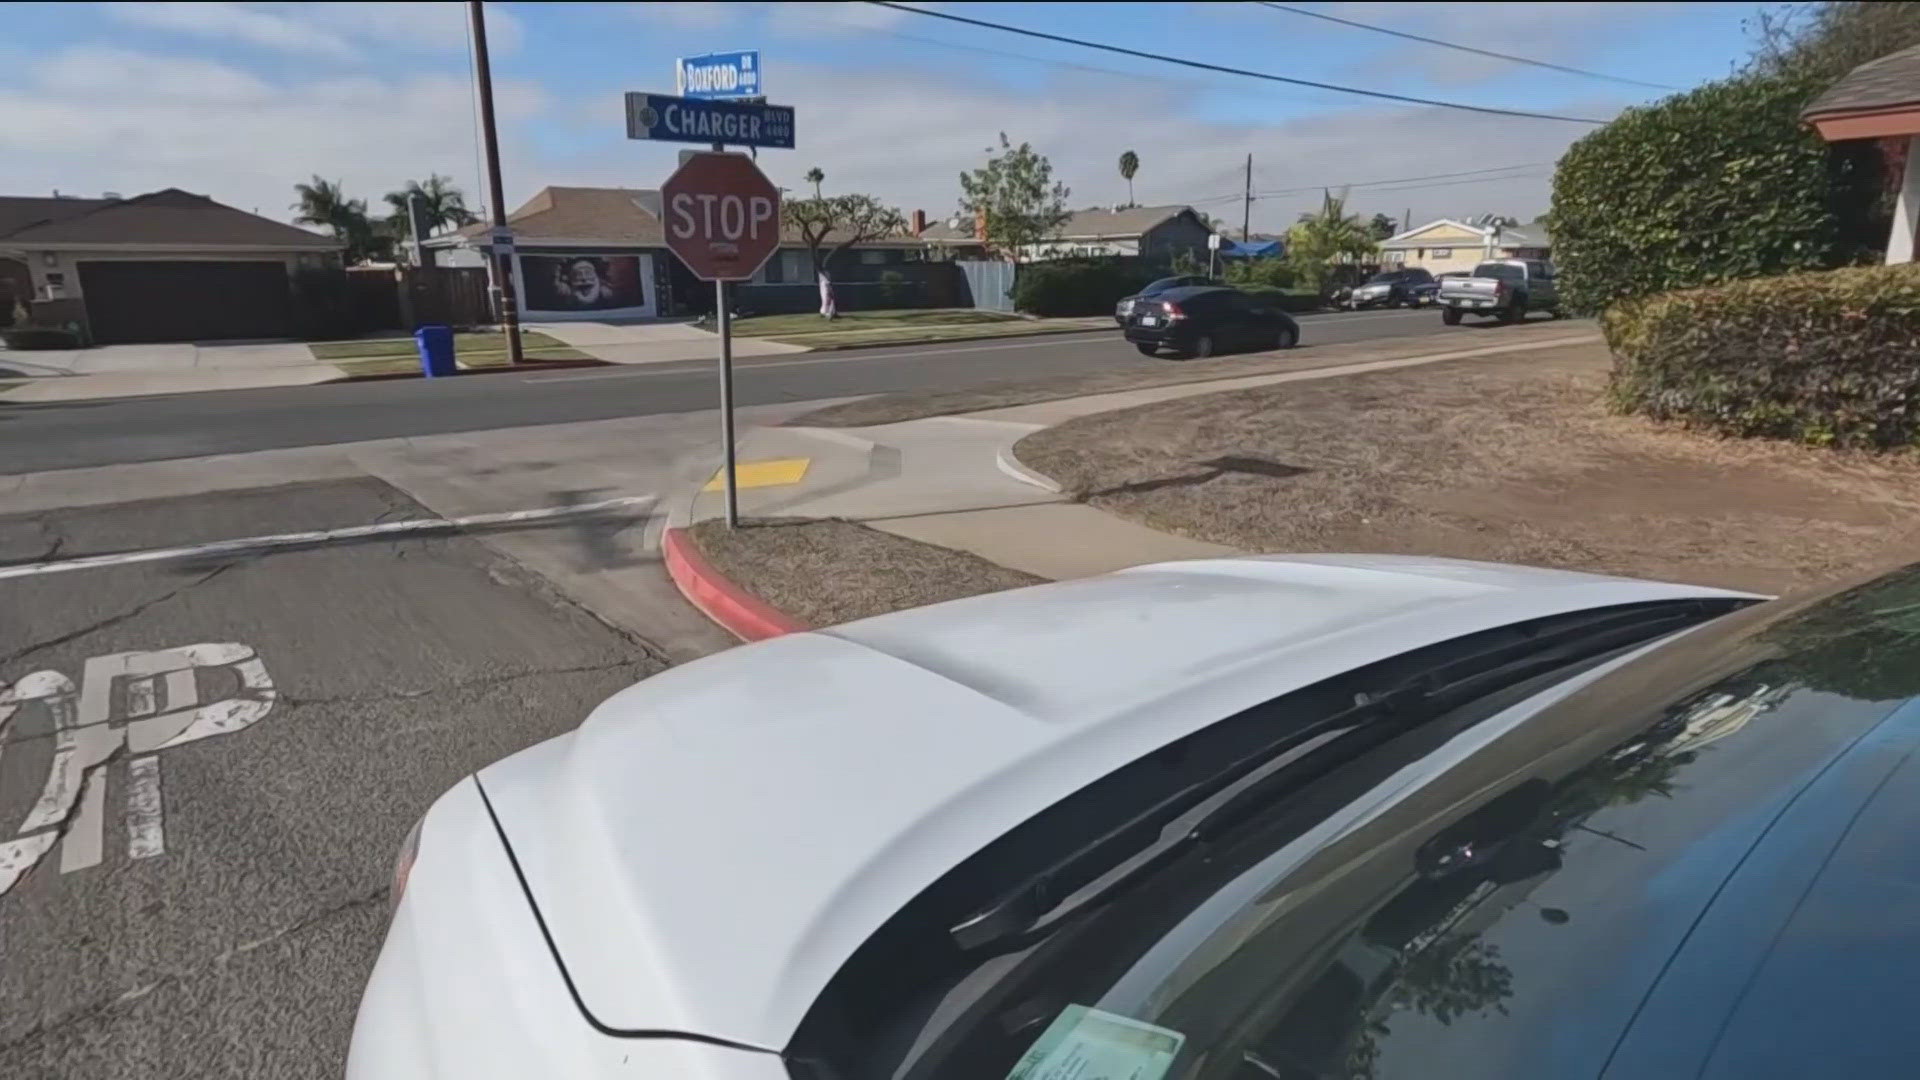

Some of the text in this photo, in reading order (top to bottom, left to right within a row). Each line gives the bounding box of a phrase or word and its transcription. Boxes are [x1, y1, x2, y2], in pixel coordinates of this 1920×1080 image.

[687, 63, 738, 92] BOXFORD
[664, 104, 762, 139] CHARGER
[764, 109, 790, 124] BLVD
[671, 192, 772, 241] STOP
